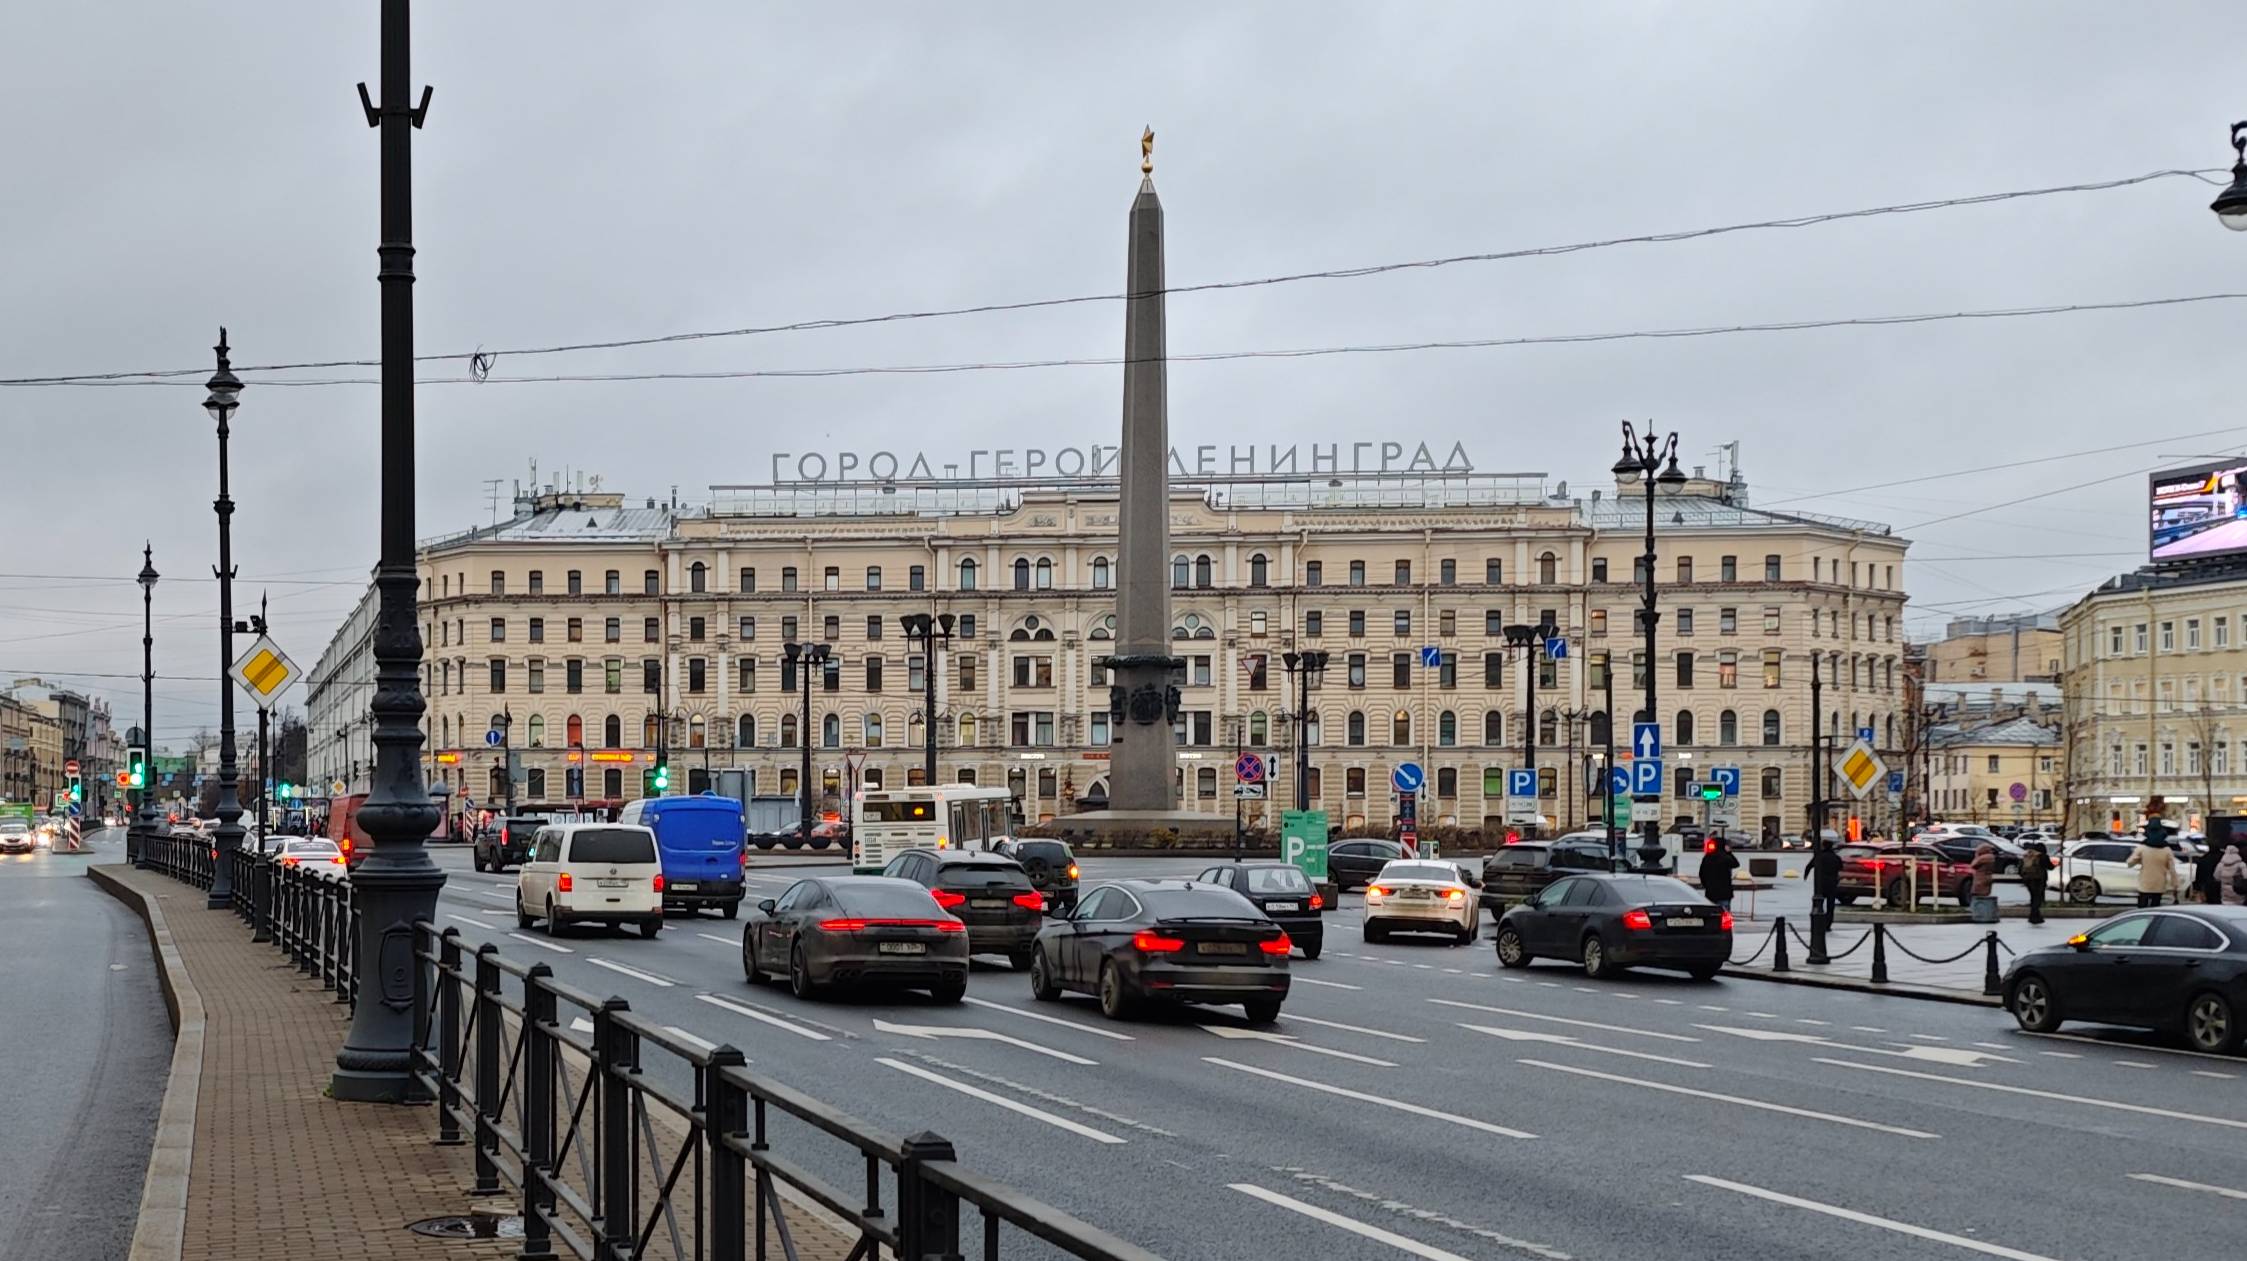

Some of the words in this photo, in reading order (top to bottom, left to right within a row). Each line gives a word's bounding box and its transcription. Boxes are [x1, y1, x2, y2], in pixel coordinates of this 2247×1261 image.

[1514, 772, 1531, 794] P
[1638, 763, 1656, 791] P
[1690, 785, 1700, 797] P
[1287, 836, 1305, 865] P
